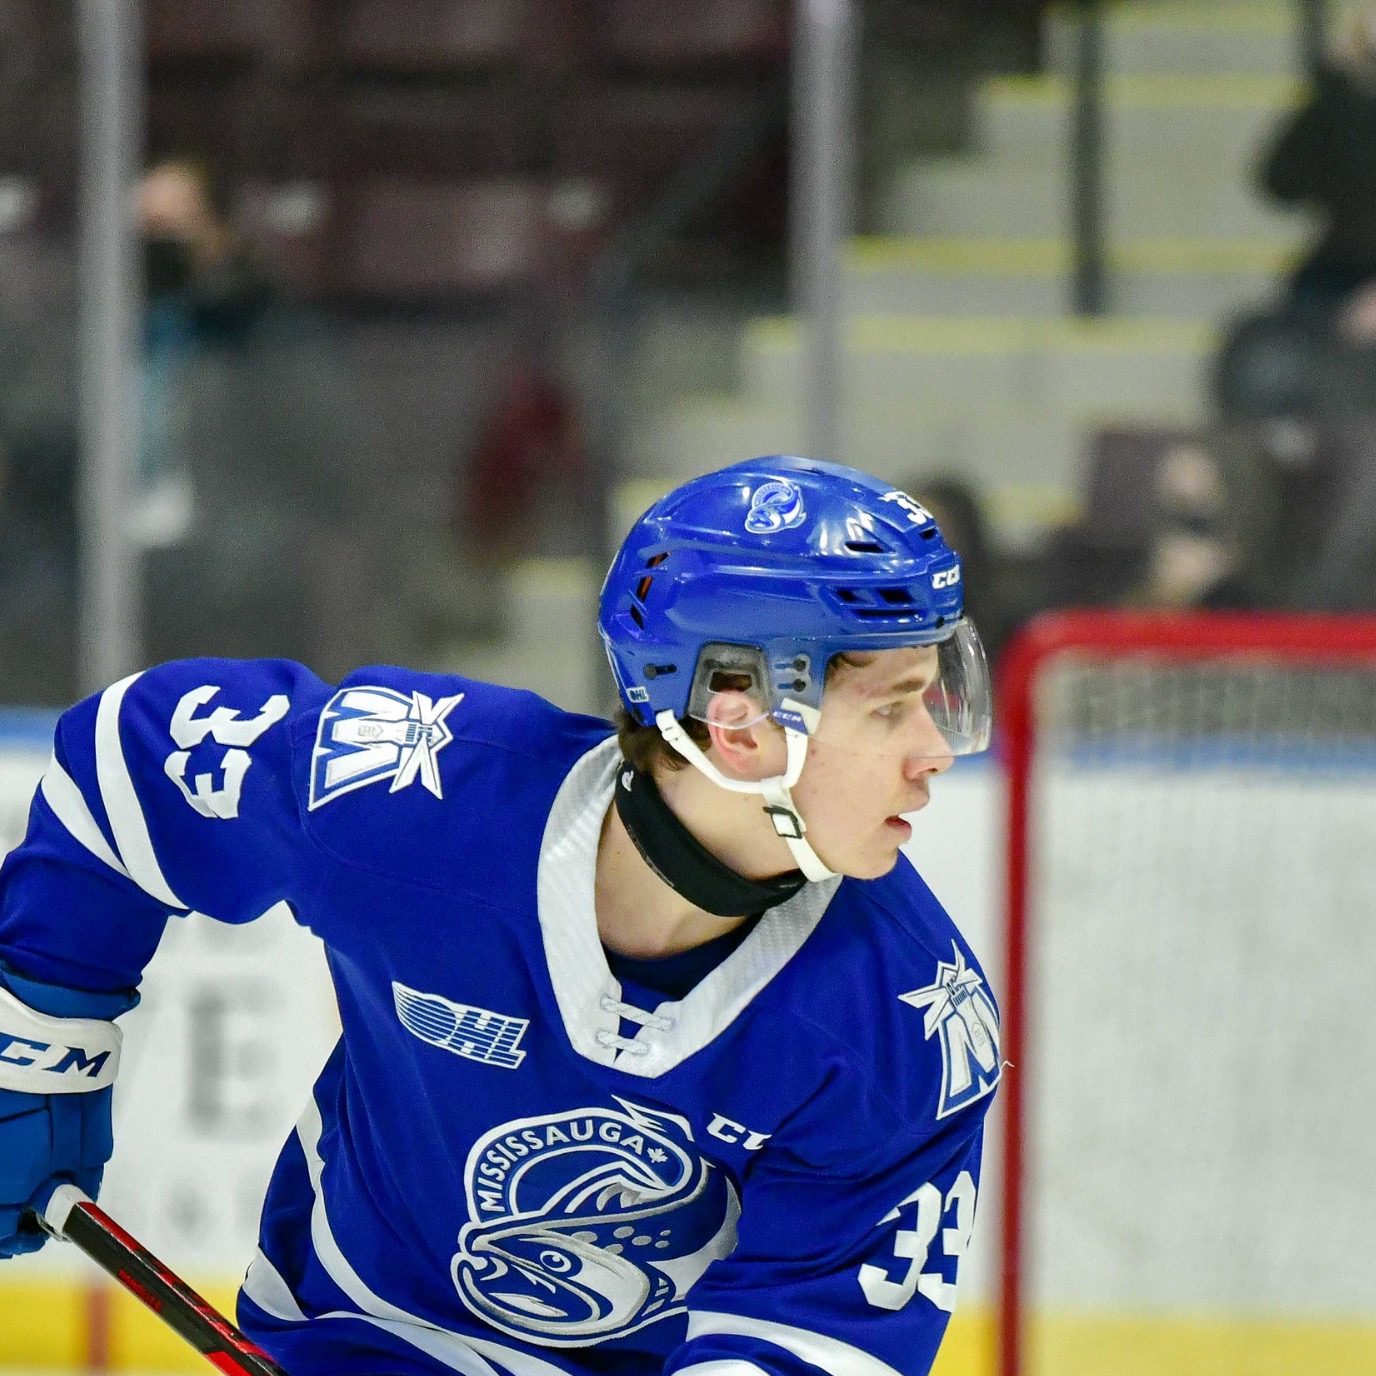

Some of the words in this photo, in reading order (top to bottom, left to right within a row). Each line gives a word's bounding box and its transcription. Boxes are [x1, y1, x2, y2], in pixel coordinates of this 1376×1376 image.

[164, 685, 290, 819] 33
[476, 1118, 645, 1213] MISSISSAUGA
[857, 1170, 977, 1314] 33
